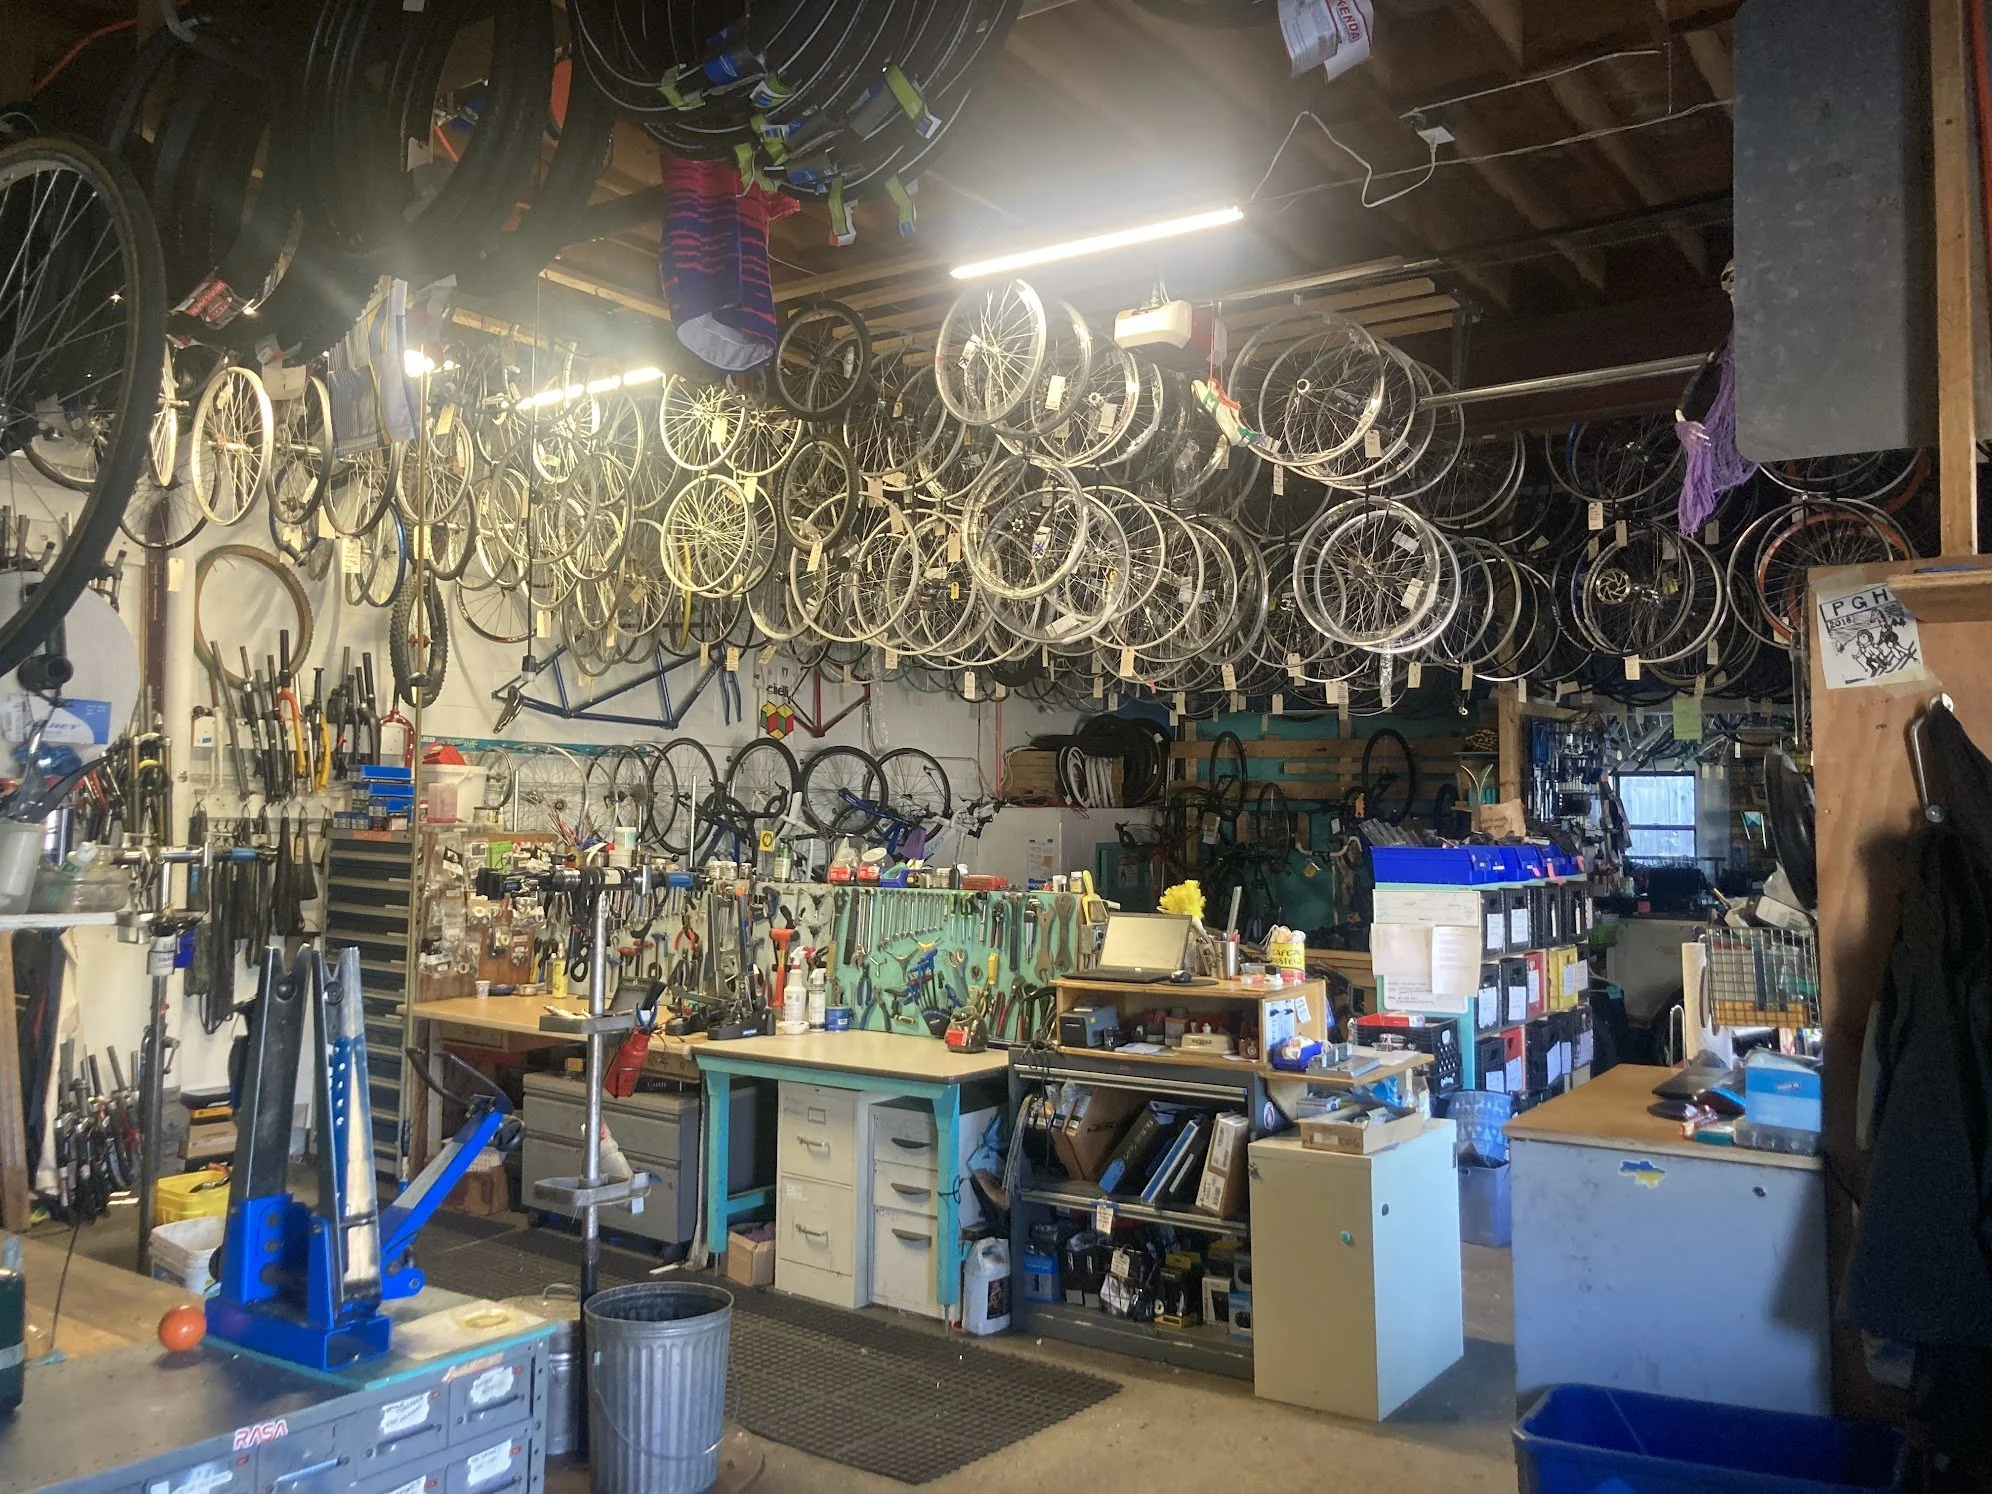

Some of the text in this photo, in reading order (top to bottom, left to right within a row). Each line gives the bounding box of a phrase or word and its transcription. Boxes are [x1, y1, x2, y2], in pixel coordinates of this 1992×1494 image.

[1336, 0, 1361, 40] KENDA
[1832, 588, 1889, 617] PGH
[1829, 616, 1853, 629] 2018
